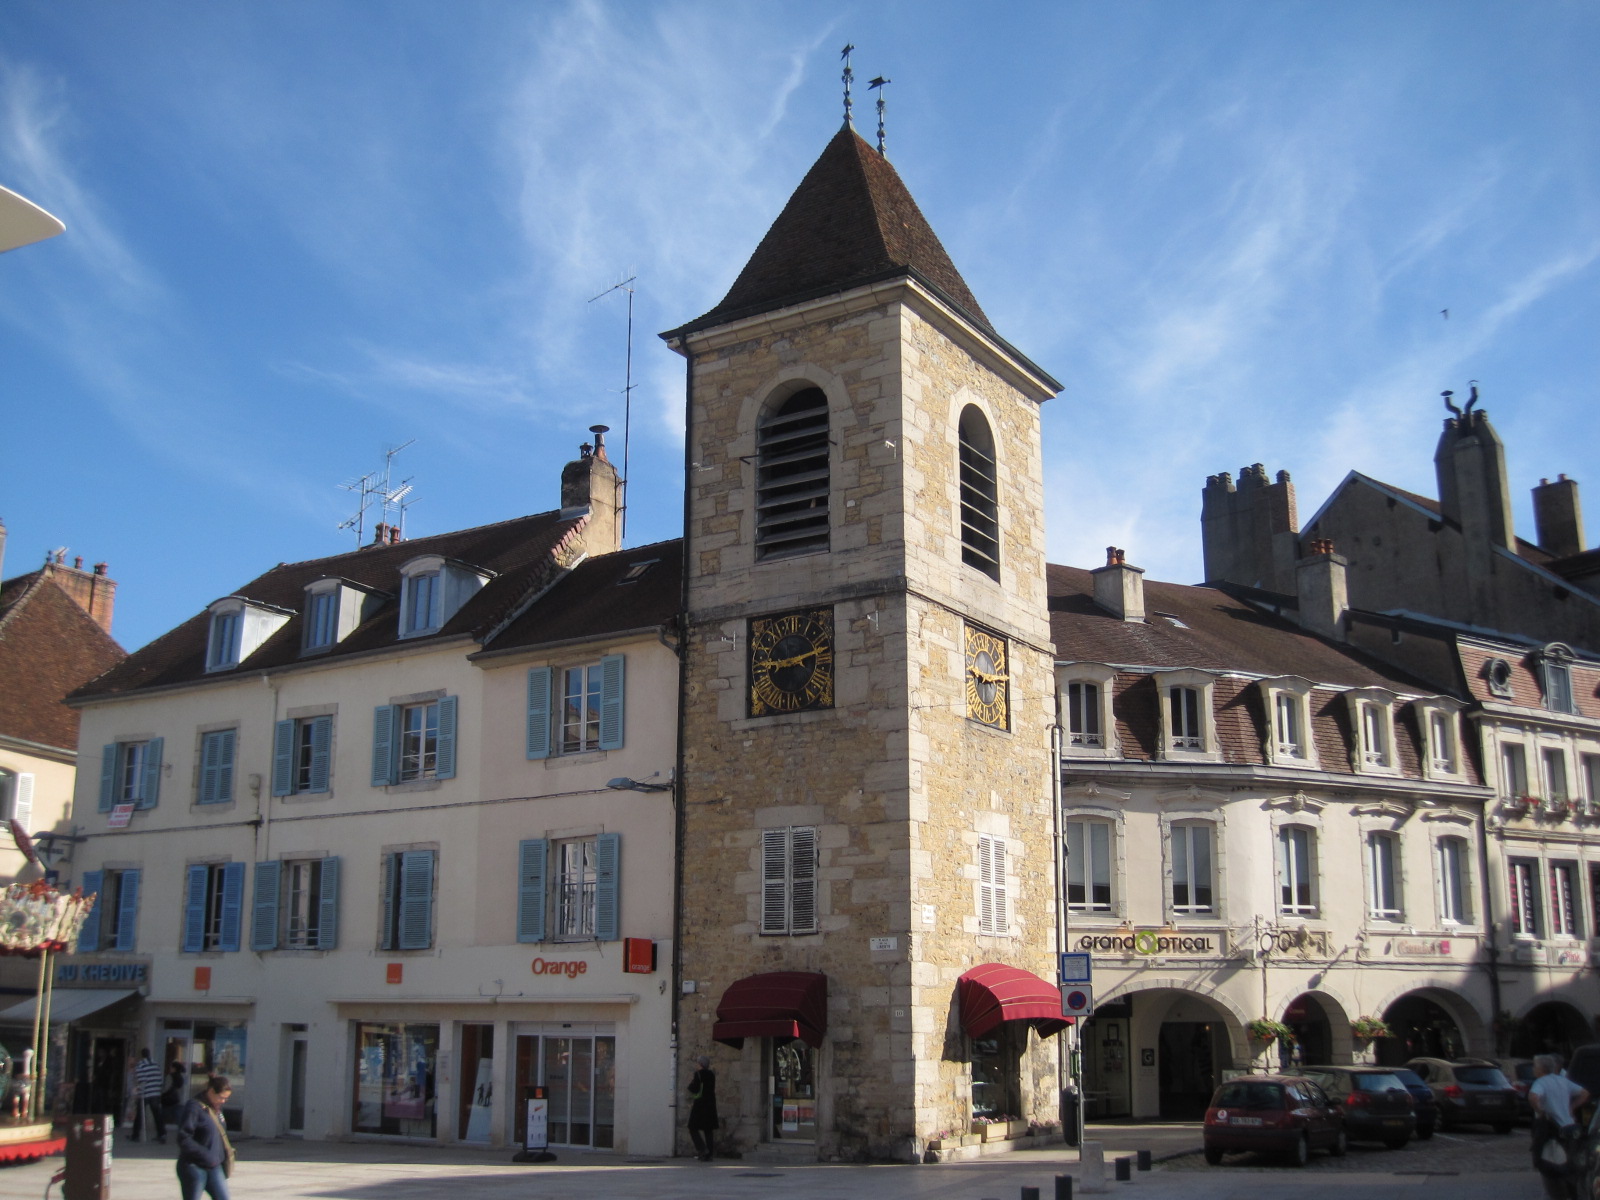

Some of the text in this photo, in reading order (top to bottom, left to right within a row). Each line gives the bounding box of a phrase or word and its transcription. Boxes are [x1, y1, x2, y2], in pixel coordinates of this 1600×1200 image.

[59, 965, 77, 981] AU
[532, 958, 587, 978] Orange
[631, 964, 651, 972] orange
